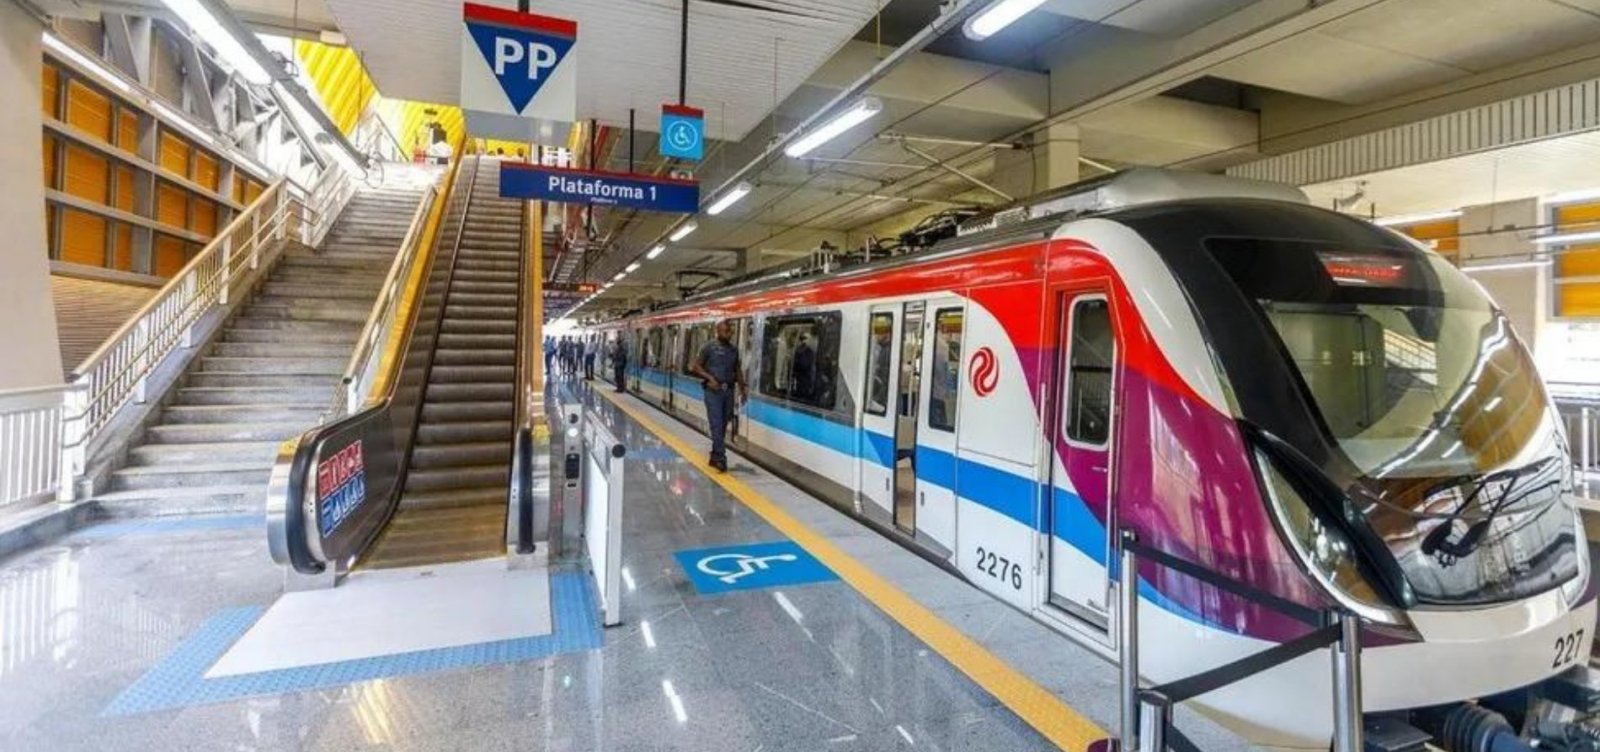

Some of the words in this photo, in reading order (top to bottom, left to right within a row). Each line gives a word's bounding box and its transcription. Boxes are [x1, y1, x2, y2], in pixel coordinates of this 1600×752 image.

[494, 36, 558, 80] PP
[548, 176, 644, 200] Plataforma
[649, 186, 657, 201] 1
[976, 546, 1022, 590] 2276
[1552, 627, 1584, 669] 227
